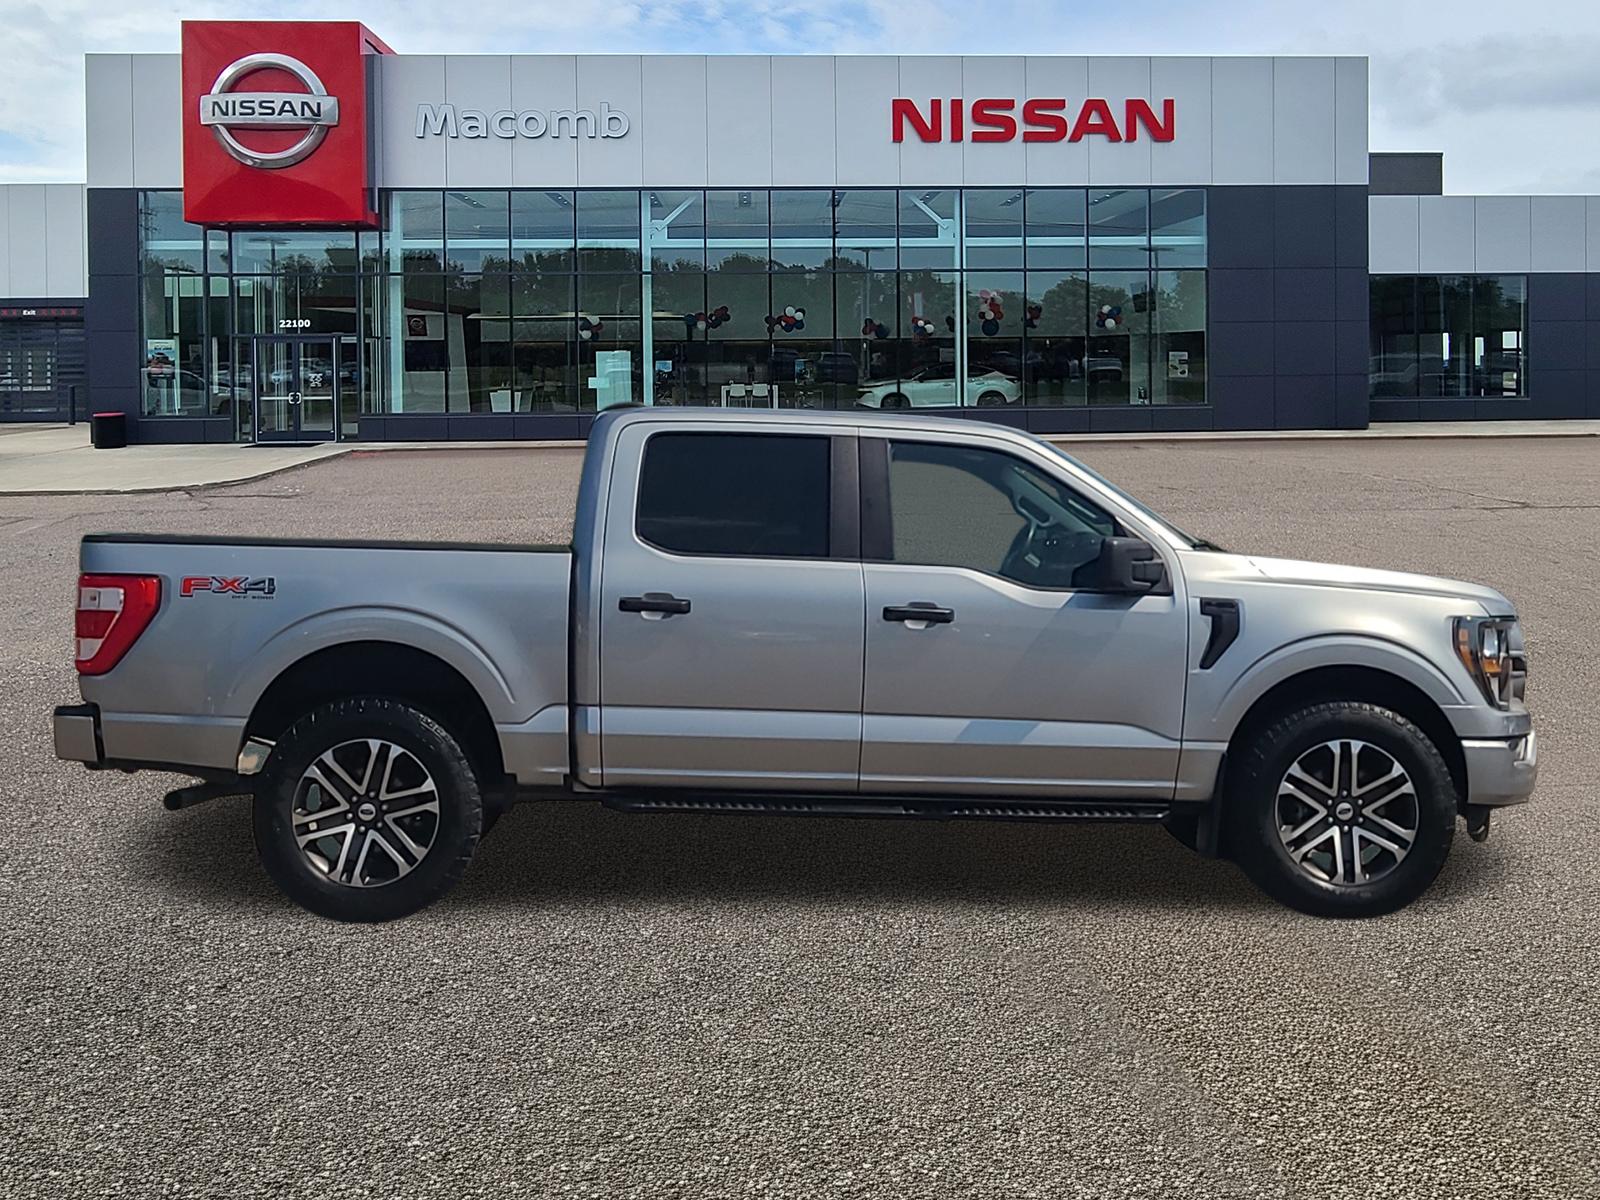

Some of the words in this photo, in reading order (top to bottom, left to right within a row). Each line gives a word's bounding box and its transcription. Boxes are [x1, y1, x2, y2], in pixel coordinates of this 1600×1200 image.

[211, 100, 322, 117] NISSAN
[415, 102, 630, 139] Macomb
[892, 98, 1175, 143] NISSAN
[279, 319, 311, 328] 22100
[180, 576, 276, 597] FX4
